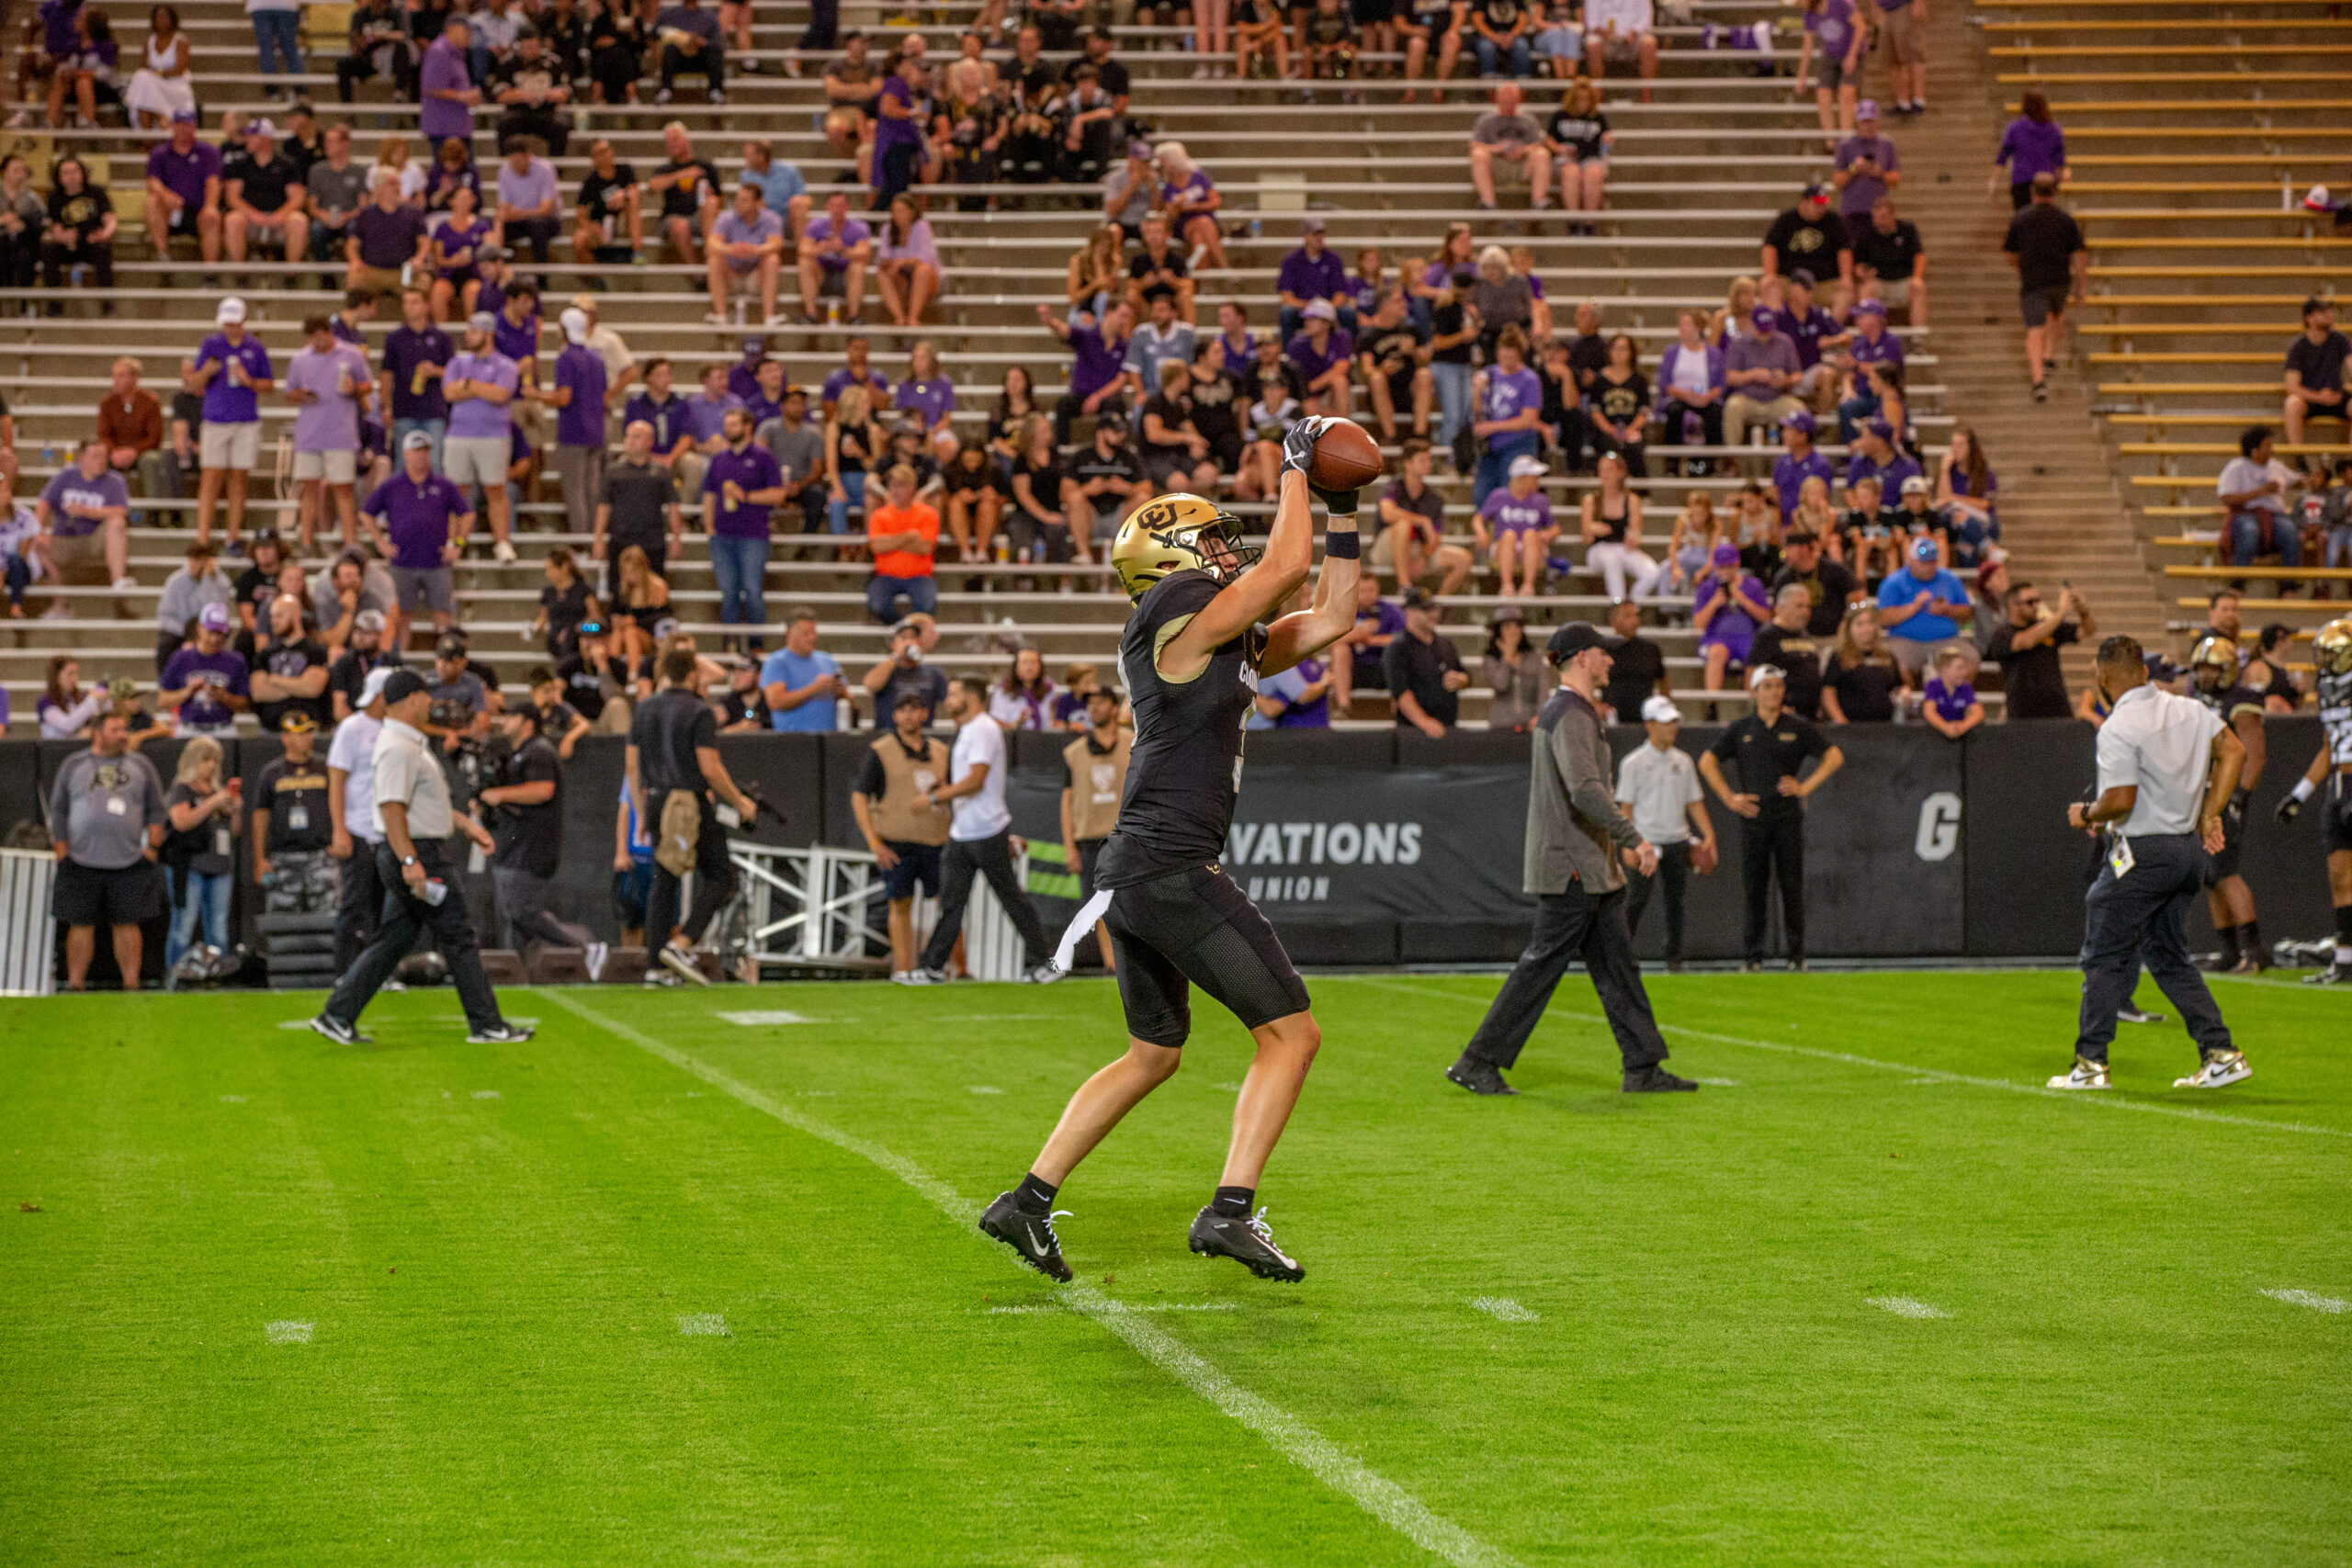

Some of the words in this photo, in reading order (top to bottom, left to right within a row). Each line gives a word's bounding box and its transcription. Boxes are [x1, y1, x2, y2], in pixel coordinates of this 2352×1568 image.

[1136, 502, 1178, 531] CU
[1219, 822, 1422, 864] VATIONS
[1915, 791, 1962, 862] G
[1248, 875, 1329, 901] UNION
